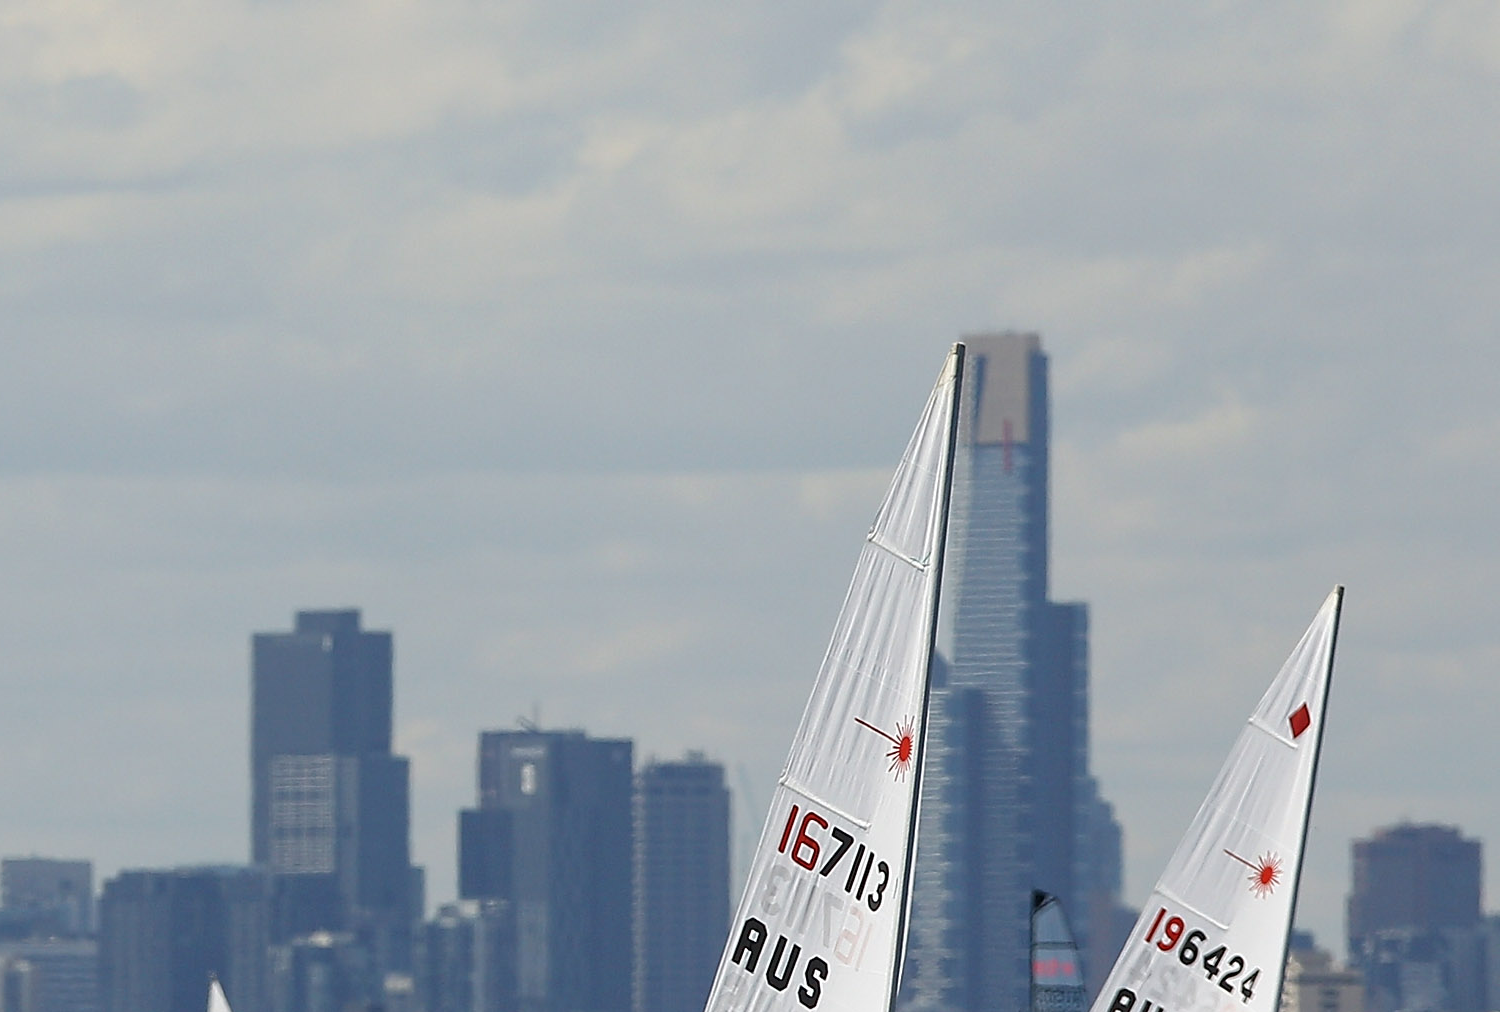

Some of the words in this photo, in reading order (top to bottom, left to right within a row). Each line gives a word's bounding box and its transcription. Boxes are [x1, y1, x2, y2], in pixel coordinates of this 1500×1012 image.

[778, 804, 890, 912] 167113
[731, 917, 829, 1010] AUS
[1144, 908, 1261, 1004] 196424
